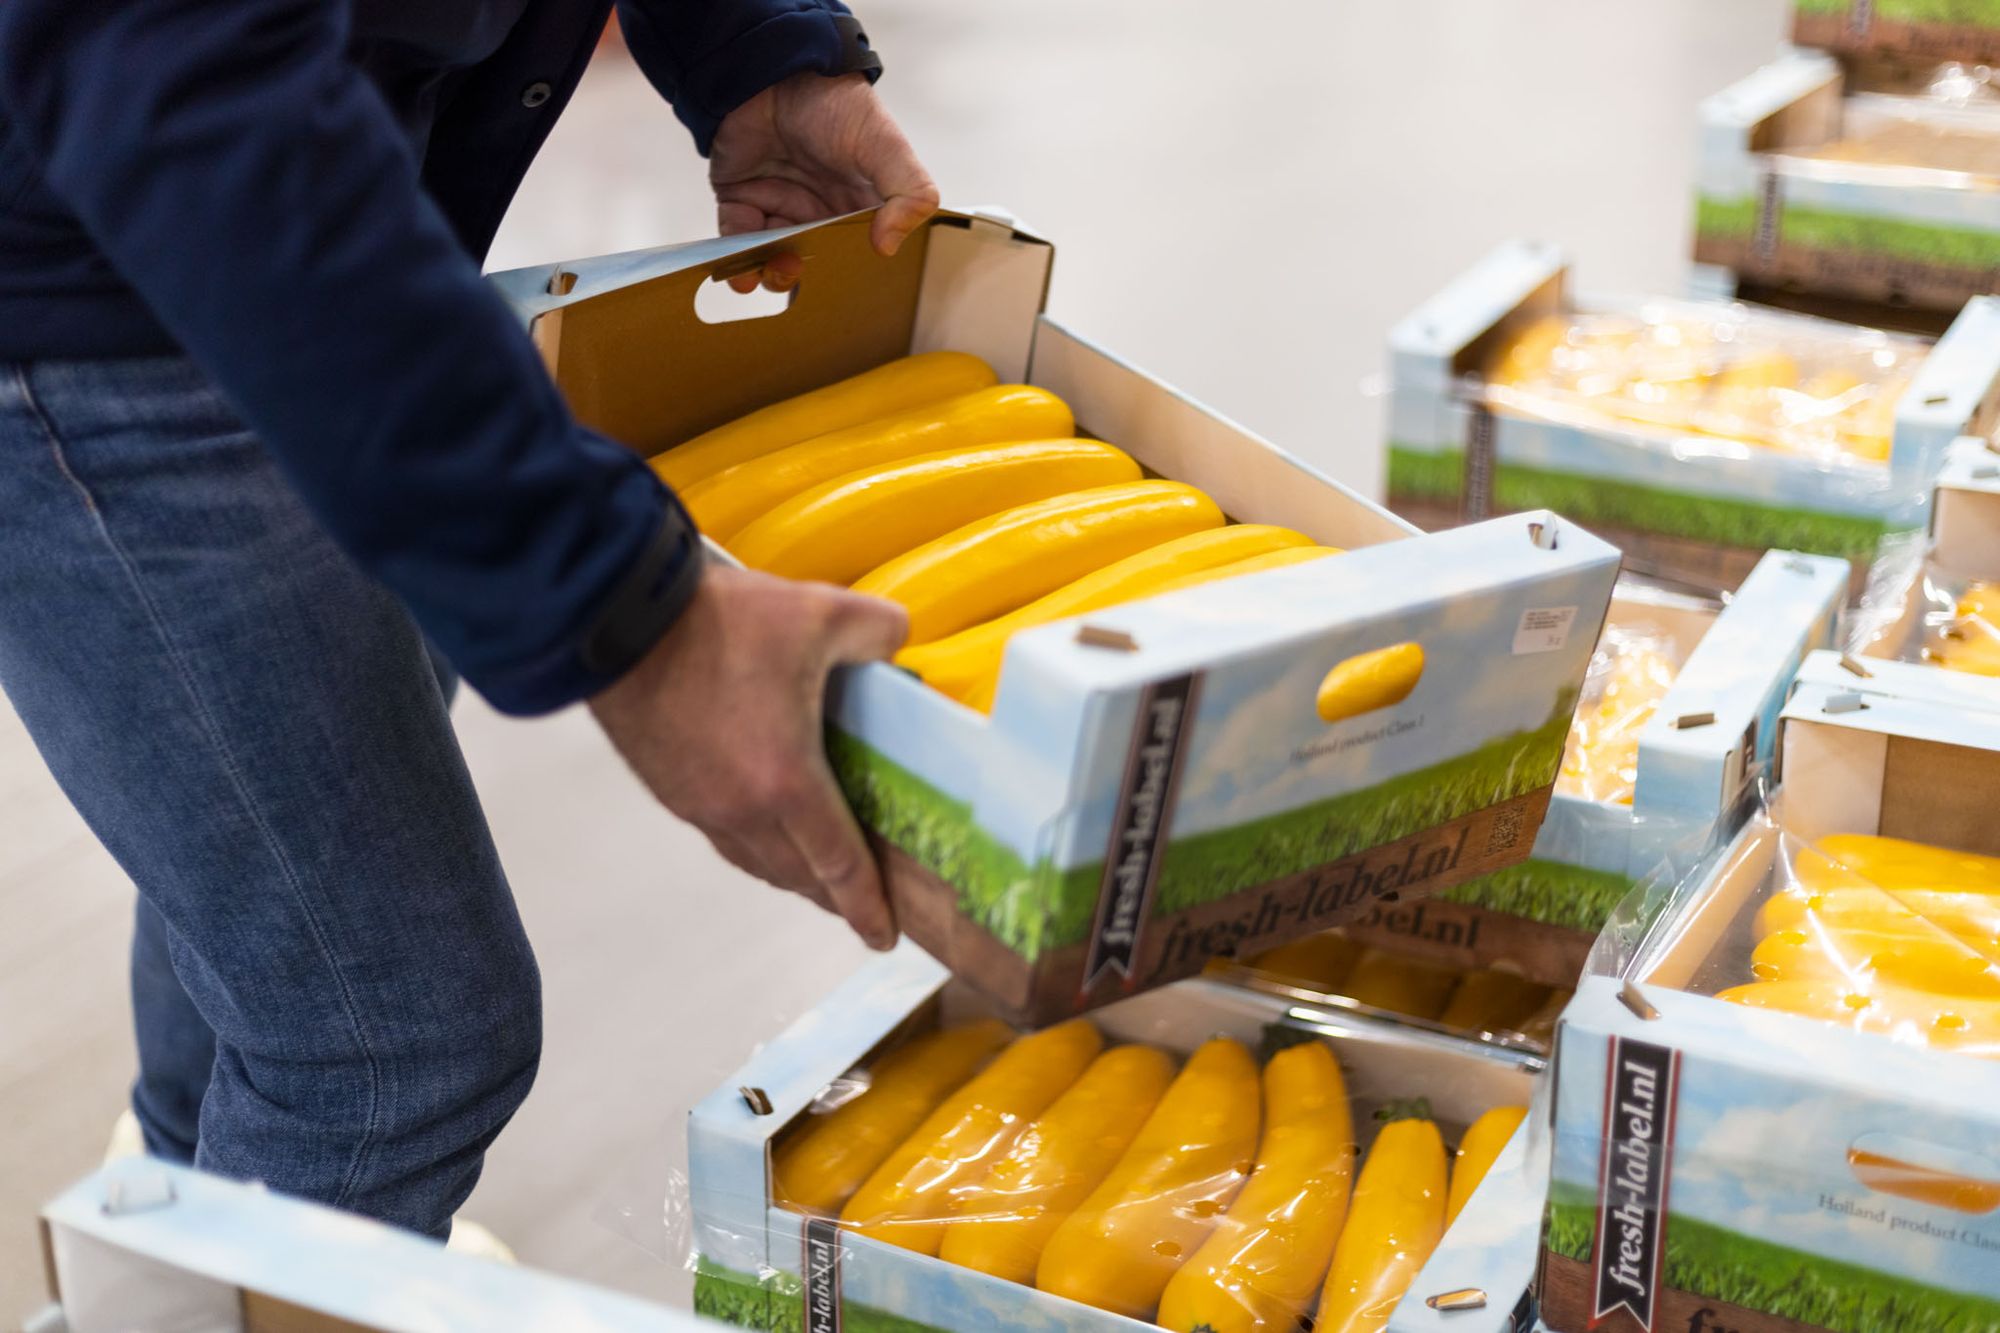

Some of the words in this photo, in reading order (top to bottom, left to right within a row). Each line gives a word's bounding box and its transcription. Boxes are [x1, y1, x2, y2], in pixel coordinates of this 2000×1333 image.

[1145, 826, 1468, 978] fresh-label.nl
[1609, 1060, 1657, 1296] fresh-label.nl
[1818, 1193, 1886, 1224] Holland
[1889, 1214, 1957, 1242] product
[1960, 1229, 2000, 1252] Clas
